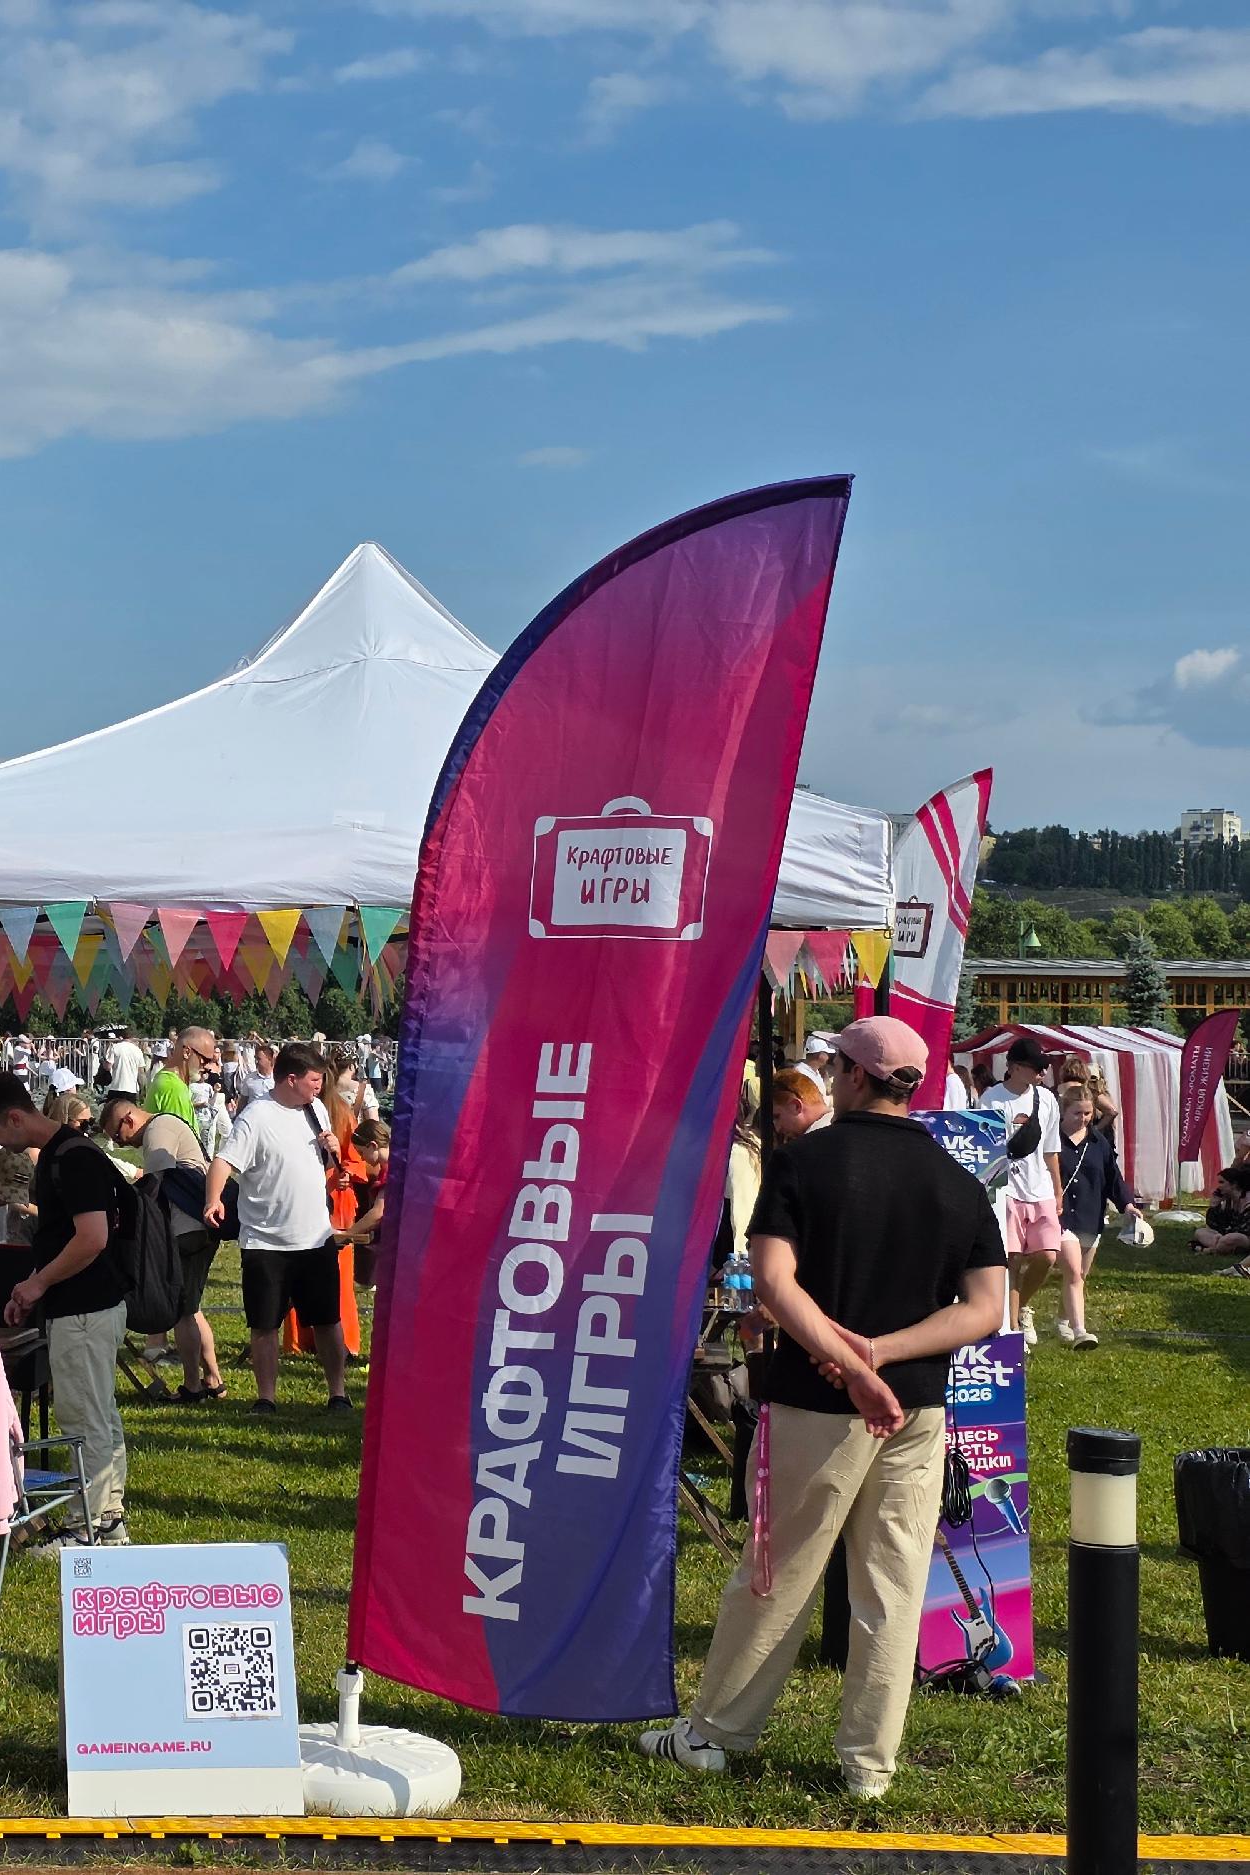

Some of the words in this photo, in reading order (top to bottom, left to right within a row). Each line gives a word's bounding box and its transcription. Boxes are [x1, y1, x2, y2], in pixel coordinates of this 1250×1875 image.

[580, 877, 650, 904] ИГРЫ
[942, 1135, 975, 1149] VK
[947, 1146, 990, 1163] est
[462, 1042, 593, 1621] КРАФТОВЫЕ
[555, 1213, 653, 1479] ИГРЫ
[948, 1361, 1013, 1387] est
[946, 1387, 992, 1403] 2026
[949, 1443, 994, 1457] СТЬ
[966, 1456, 1012, 1471] ЯДКИ
[73, 1611, 165, 1640] игры
[76, 1741, 212, 1754] GAMEINGAME.RU
